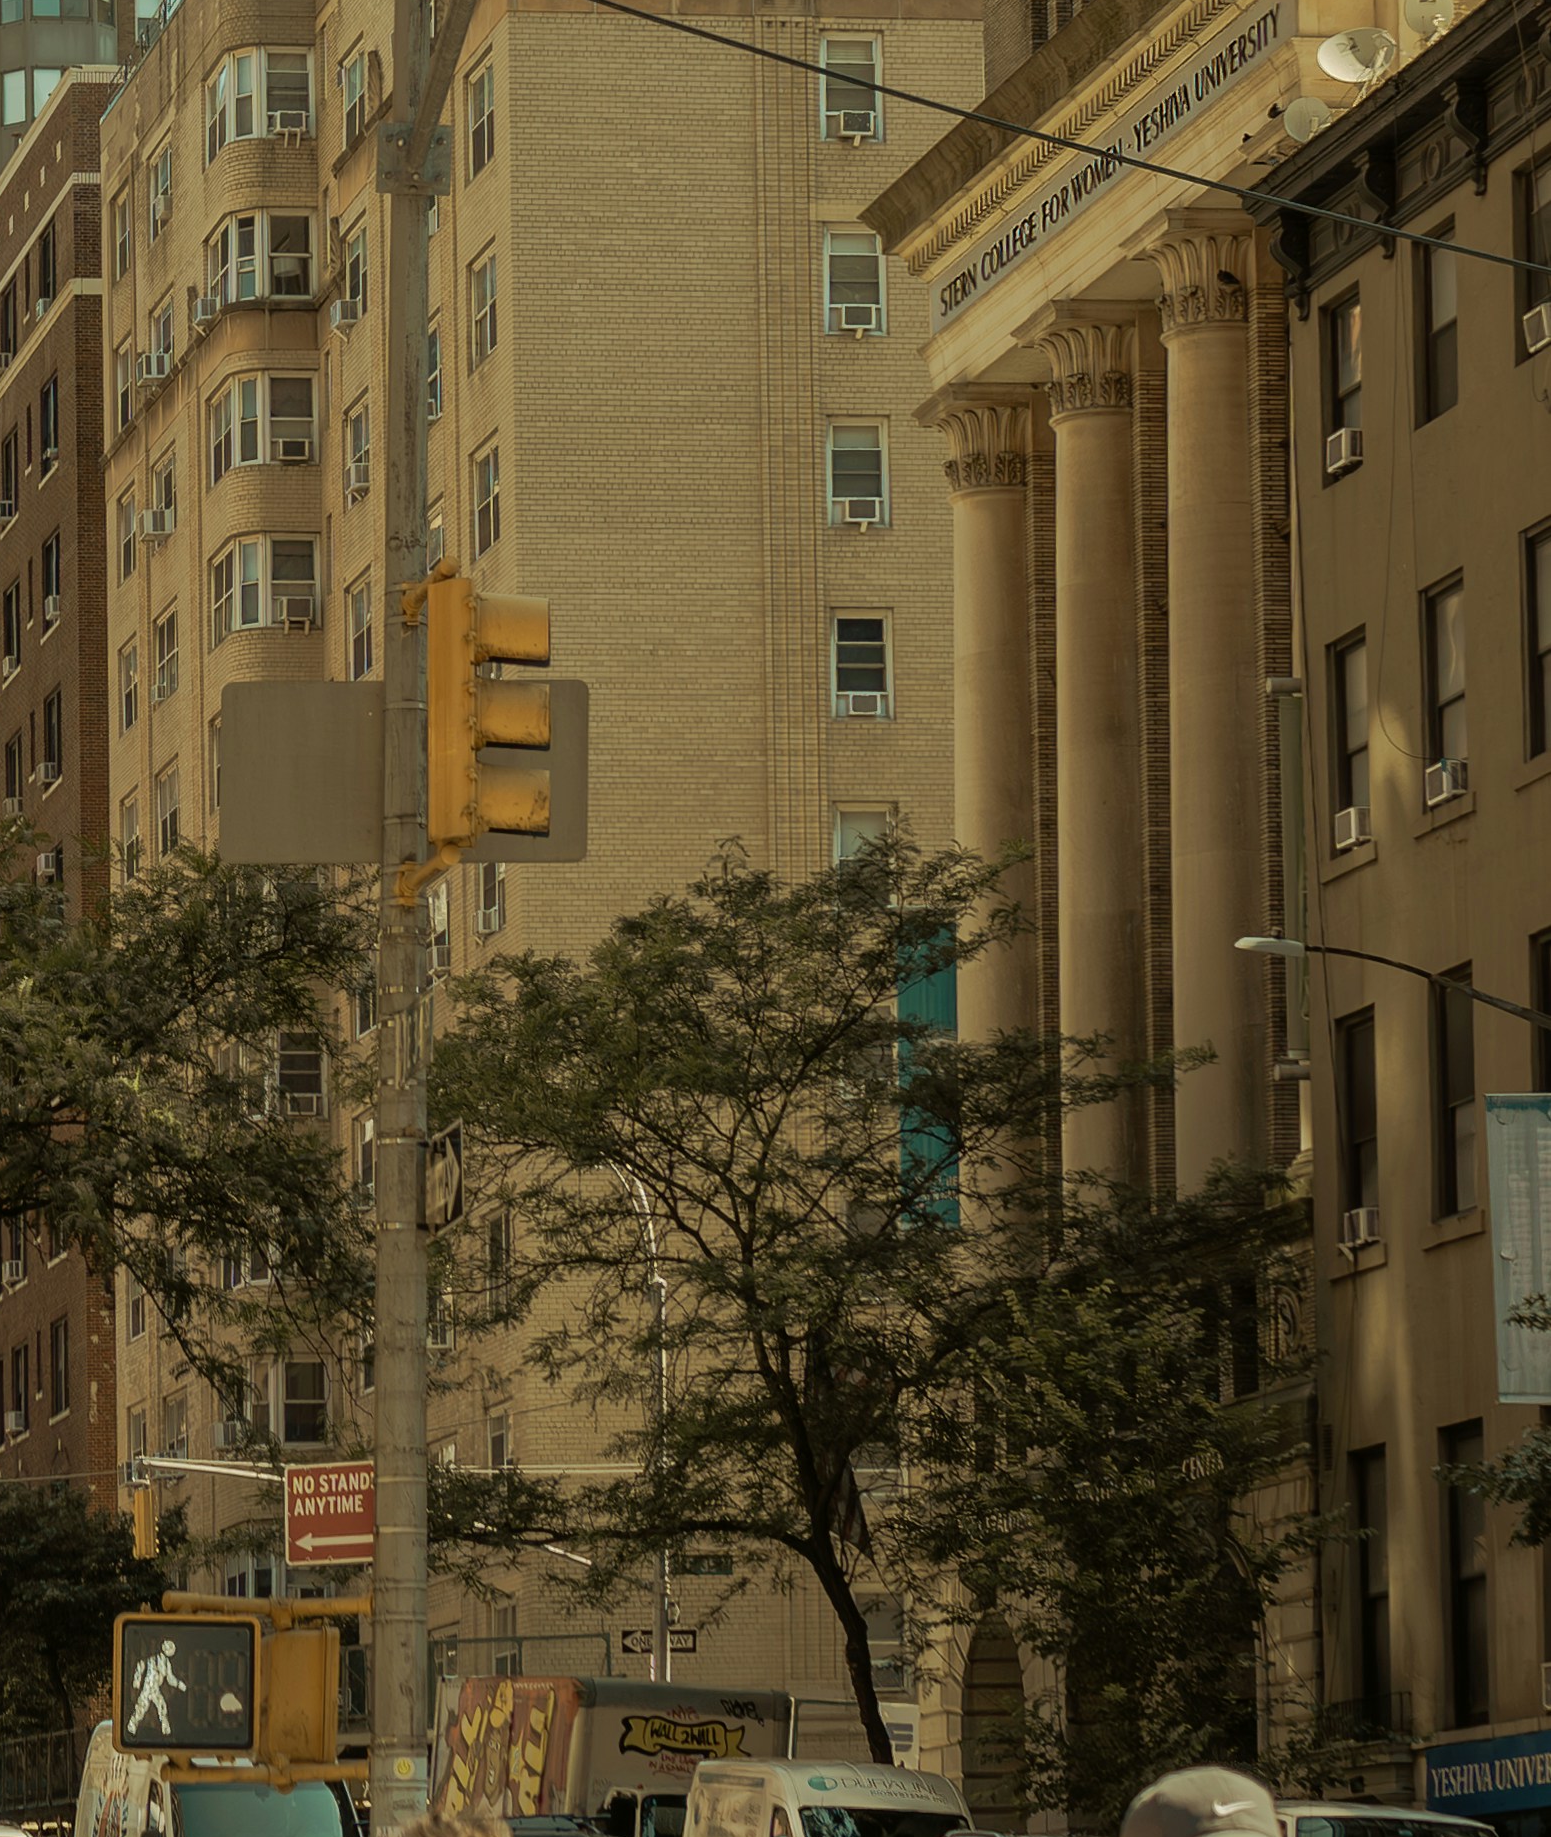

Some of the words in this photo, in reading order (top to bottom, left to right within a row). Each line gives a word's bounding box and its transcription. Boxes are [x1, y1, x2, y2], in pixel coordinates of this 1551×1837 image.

[940, 263, 977, 316] STERN
[981, 212, 1038, 281] COLLEGE
[1041, 186, 1070, 232] FOR
[1071, 138, 1123, 205] WOMEN
[1133, 83, 1191, 152] YESHIVA
[1194, 3, 1280, 102] UNIVERSITY
[292, 1475, 315, 1495] NO
[294, 1494, 364, 1517] ANYTIME
[1431, 1762, 1494, 1798] YESHIVA
